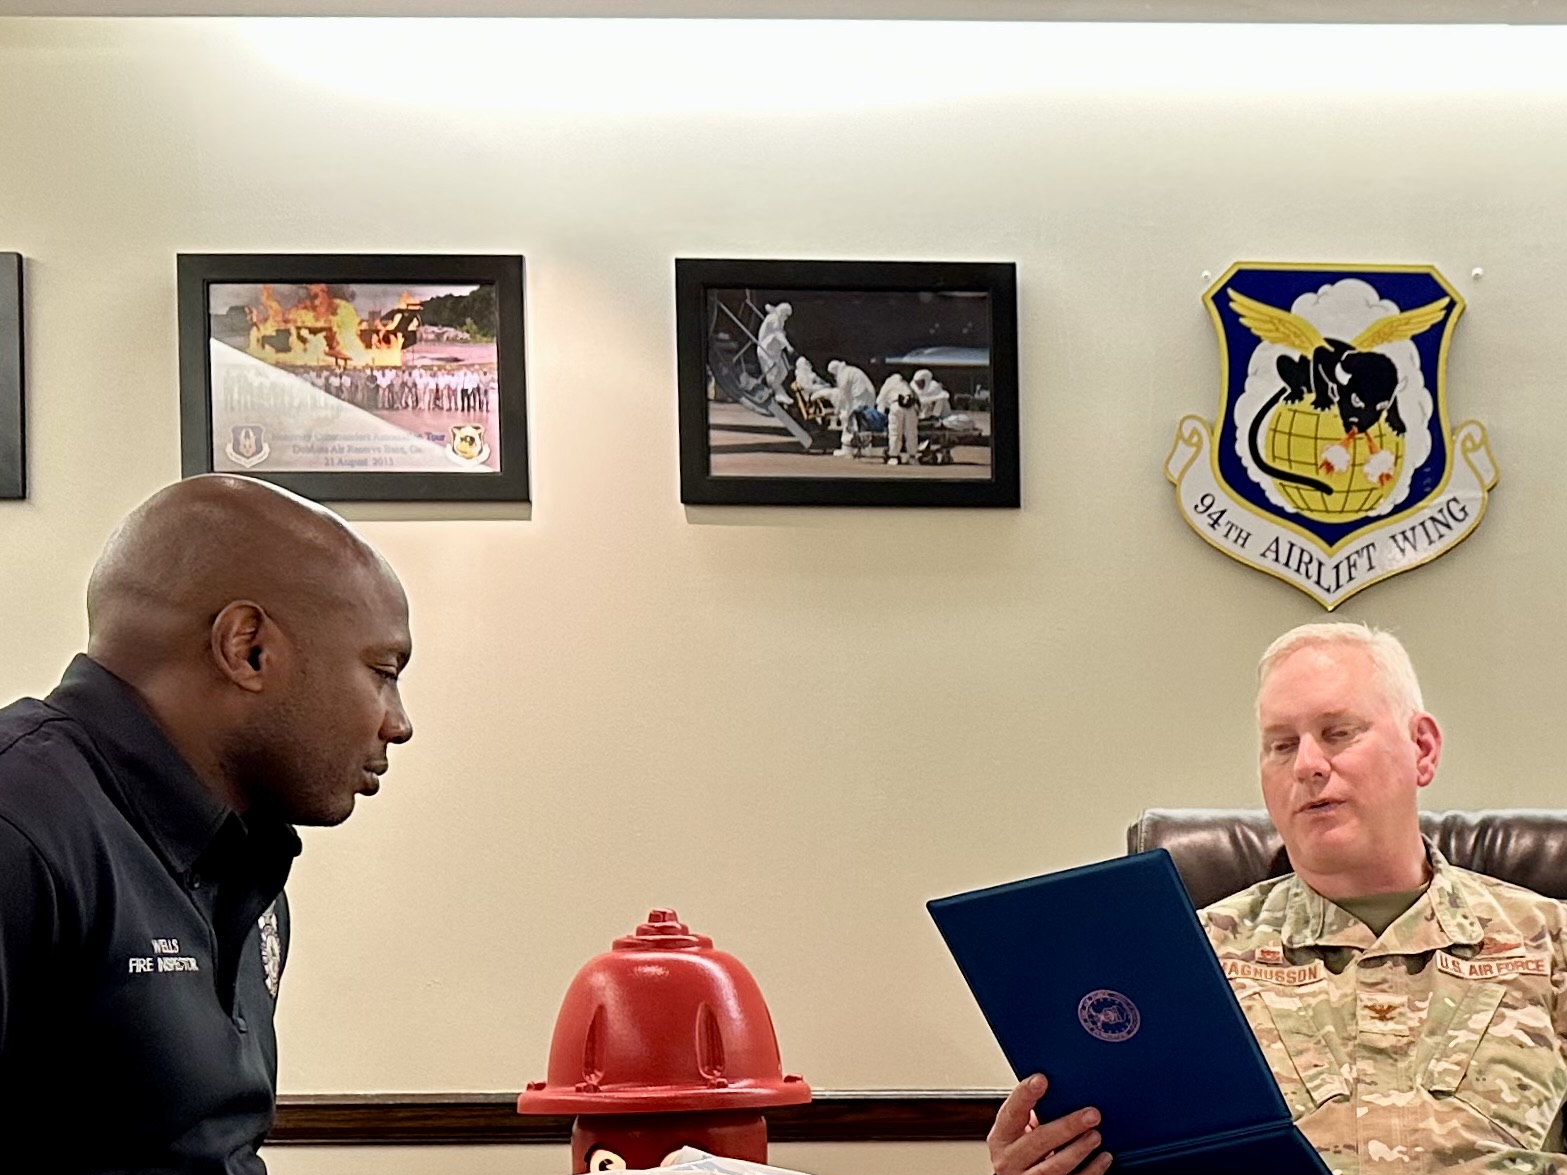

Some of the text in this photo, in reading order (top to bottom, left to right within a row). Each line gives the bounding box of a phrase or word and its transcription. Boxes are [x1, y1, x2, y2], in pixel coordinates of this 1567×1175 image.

[425, 432, 446, 441] Tour
[336, 457, 369, 468] August
[1193, 492, 1470, 595] 94TH AIRLIFT WING
[151, 938, 180, 954] WELLS
[128, 957, 155, 973] FIRE
[1469, 964, 1494, 976] AIR
[1496, 960, 1544, 973] FORCE
